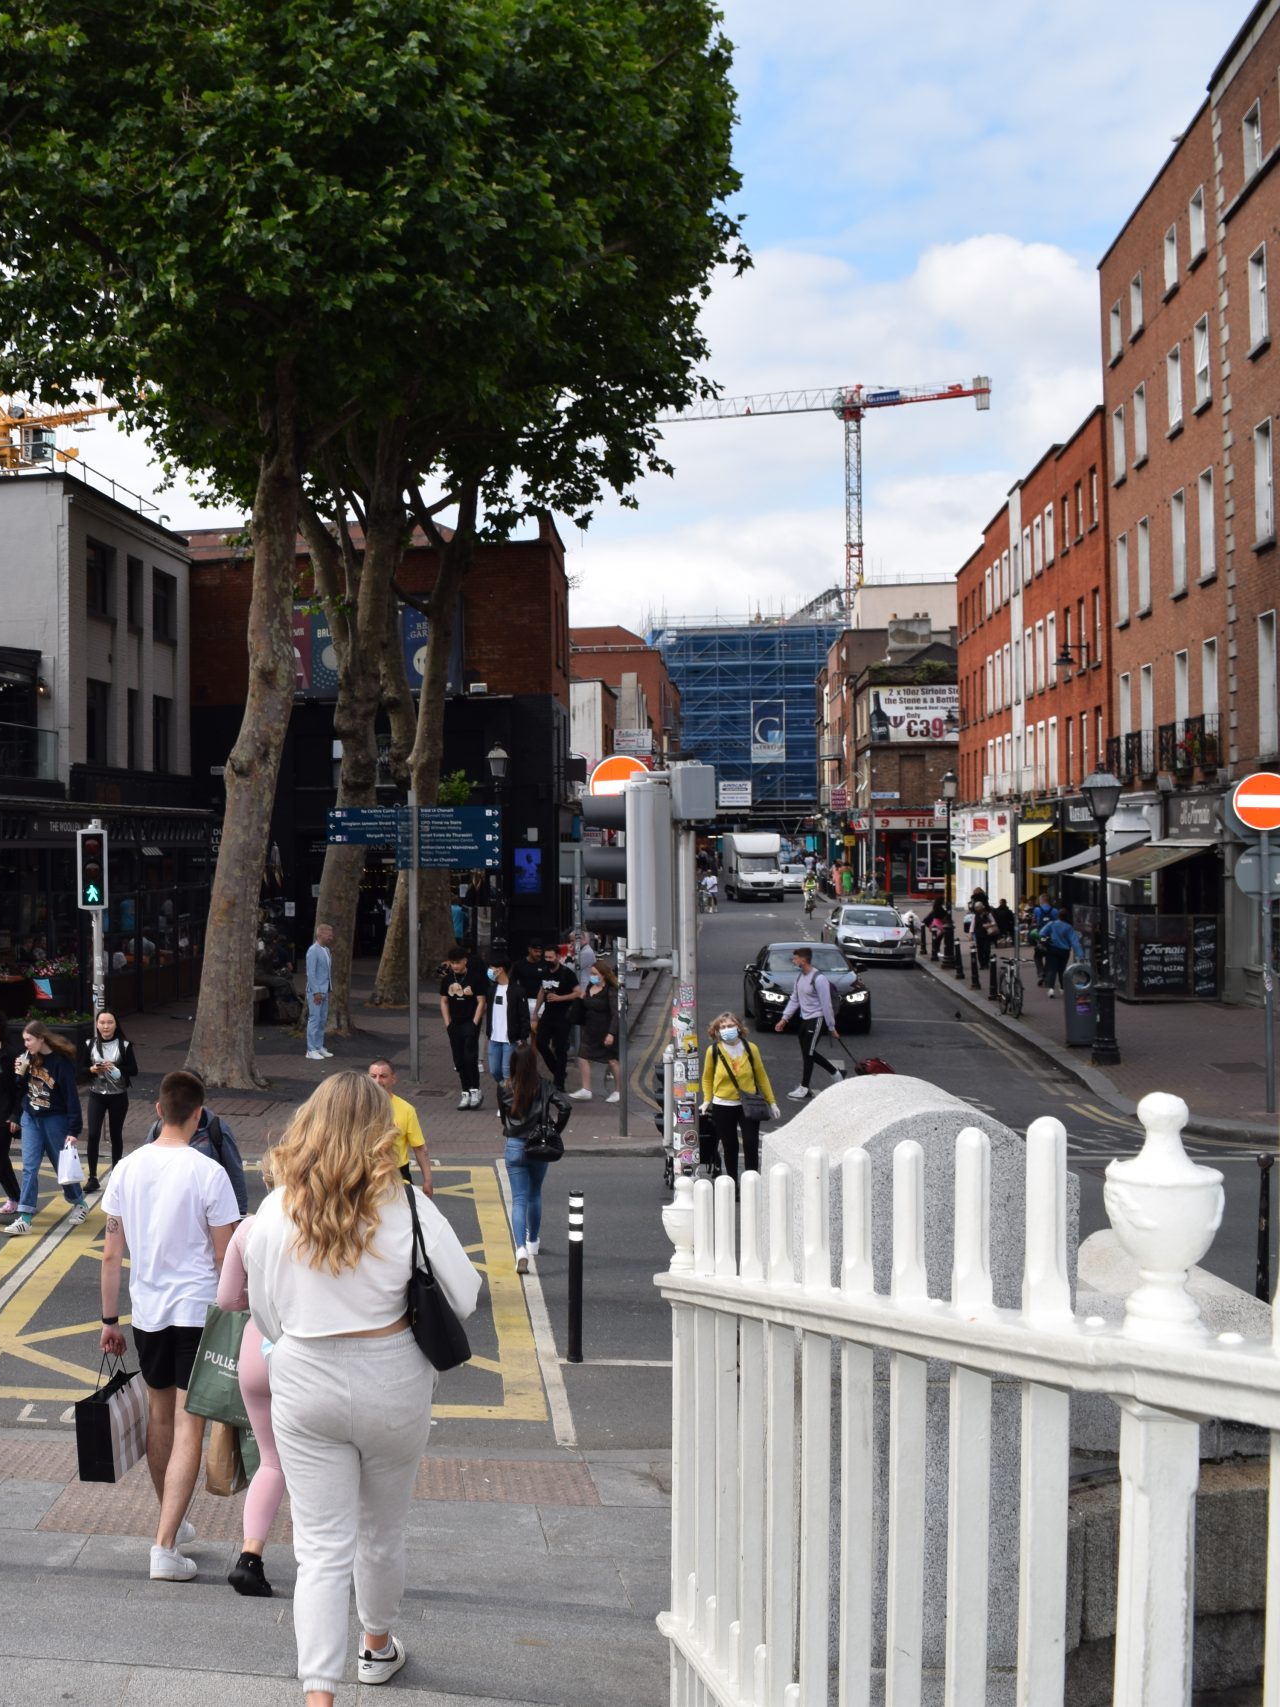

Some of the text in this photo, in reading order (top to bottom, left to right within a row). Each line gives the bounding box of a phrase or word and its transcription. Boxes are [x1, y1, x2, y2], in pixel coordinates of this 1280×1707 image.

[888, 688, 893, 696] 2
[920, 687, 947, 696] Sirloin
[898, 696, 921, 704] Stone
[906, 717, 944, 739] €39
[880, 818, 935, 828] 9 THE
